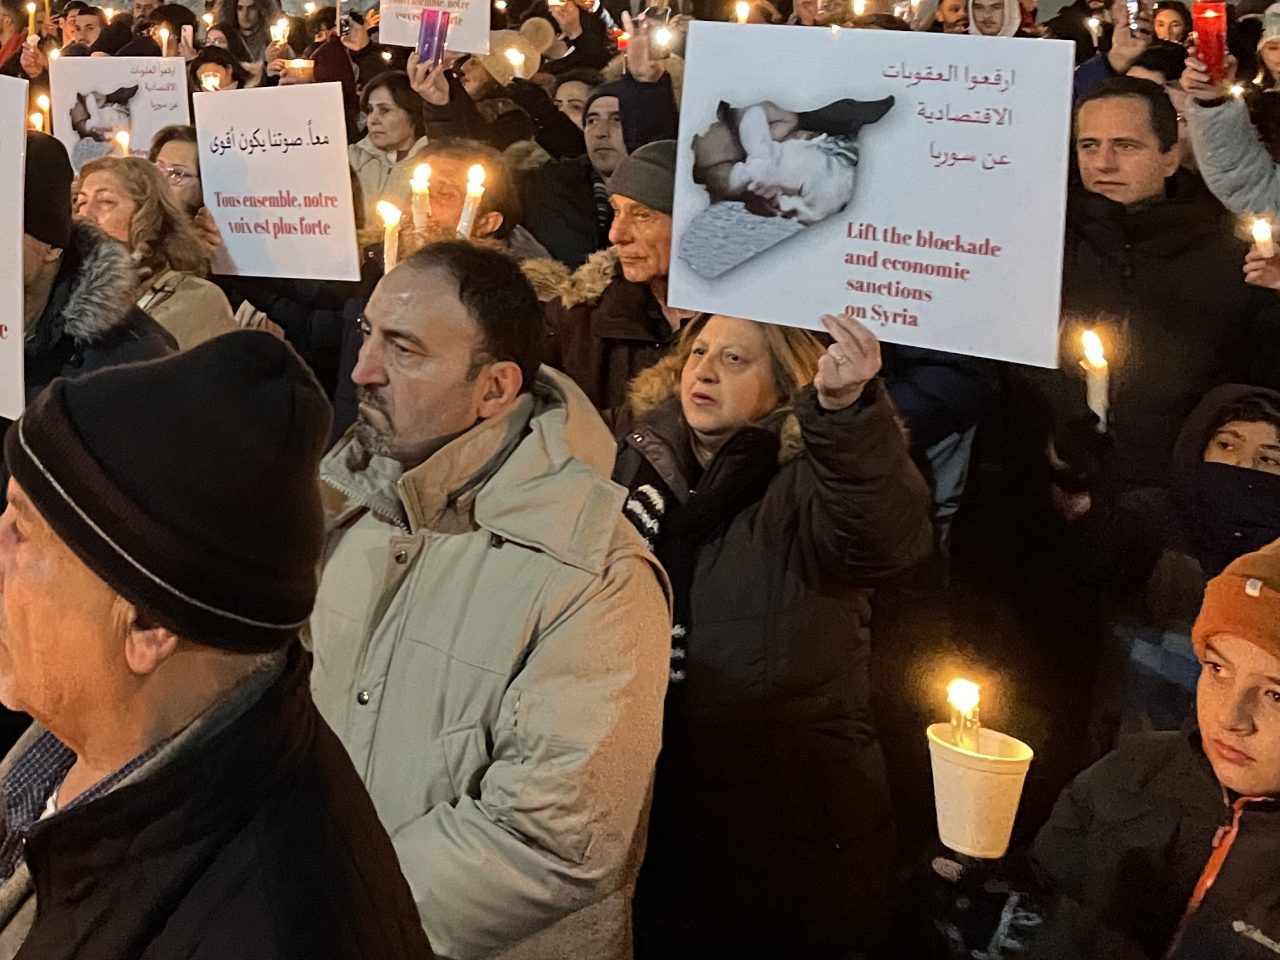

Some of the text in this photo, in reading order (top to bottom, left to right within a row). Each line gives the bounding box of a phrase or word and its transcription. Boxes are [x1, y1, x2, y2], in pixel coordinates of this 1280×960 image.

[882, 62, 1016, 92] ارفعوا العقوبات
[918, 102, 1012, 126] الاقتصادية
[210, 126, 235, 155] أقوى
[239, 128, 267, 155] يكون
[268, 128, 303, 154] صوتنا
[930, 141, 1011, 169] عن سوريا
[214, 191, 242, 208] Tous
[304, 192, 338, 208] notre
[228, 216, 331, 239] voix est plus forte
[847, 222, 1002, 257] Lift the blockade
[844, 251, 970, 281] and economic
[846, 279, 933, 302] sanctions
[844, 304, 919, 327] on Syria
